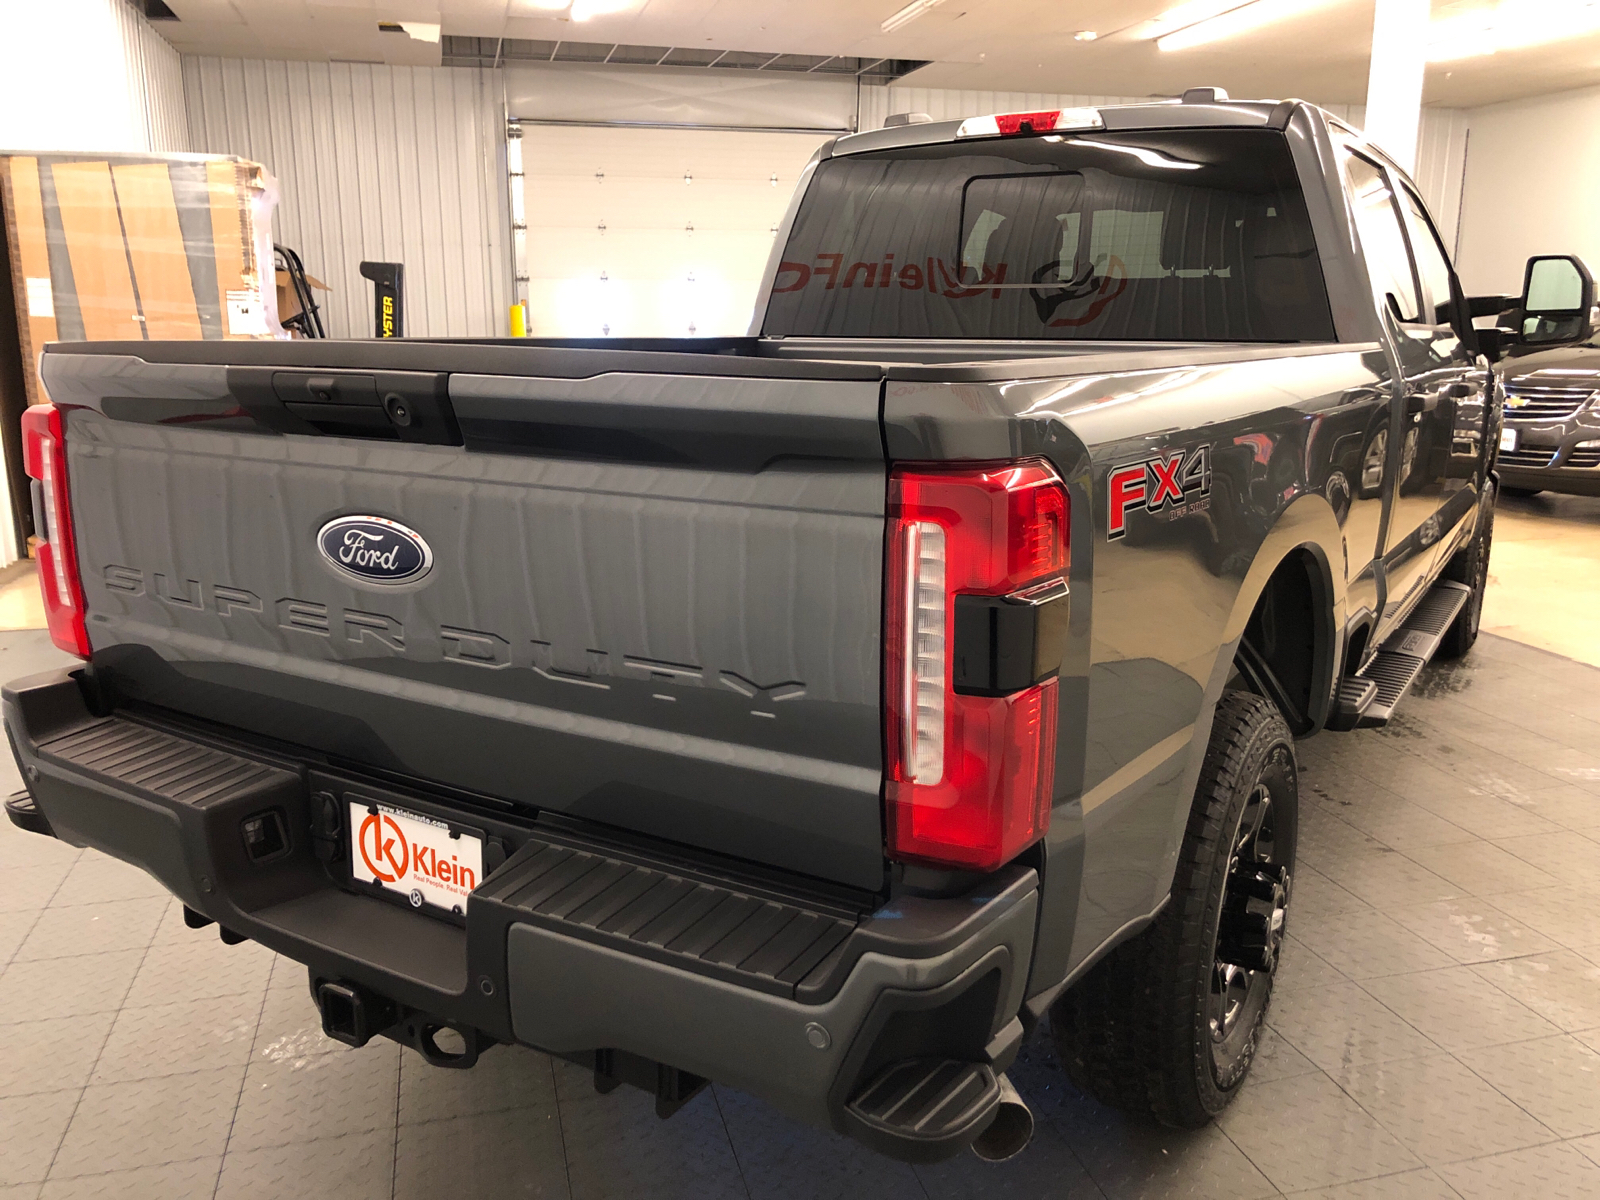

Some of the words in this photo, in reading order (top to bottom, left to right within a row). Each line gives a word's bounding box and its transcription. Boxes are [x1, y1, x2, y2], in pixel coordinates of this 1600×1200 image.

[1107, 444, 1212, 542] FX4
[339, 529, 399, 570] Ford
[103, 564, 406, 651] SUPER
[440, 624, 806, 719] DUTY
[376, 804, 448, 830] www.kleinauto.com
[412, 843, 475, 890] Klein
[413, 874, 425, 883] Real
